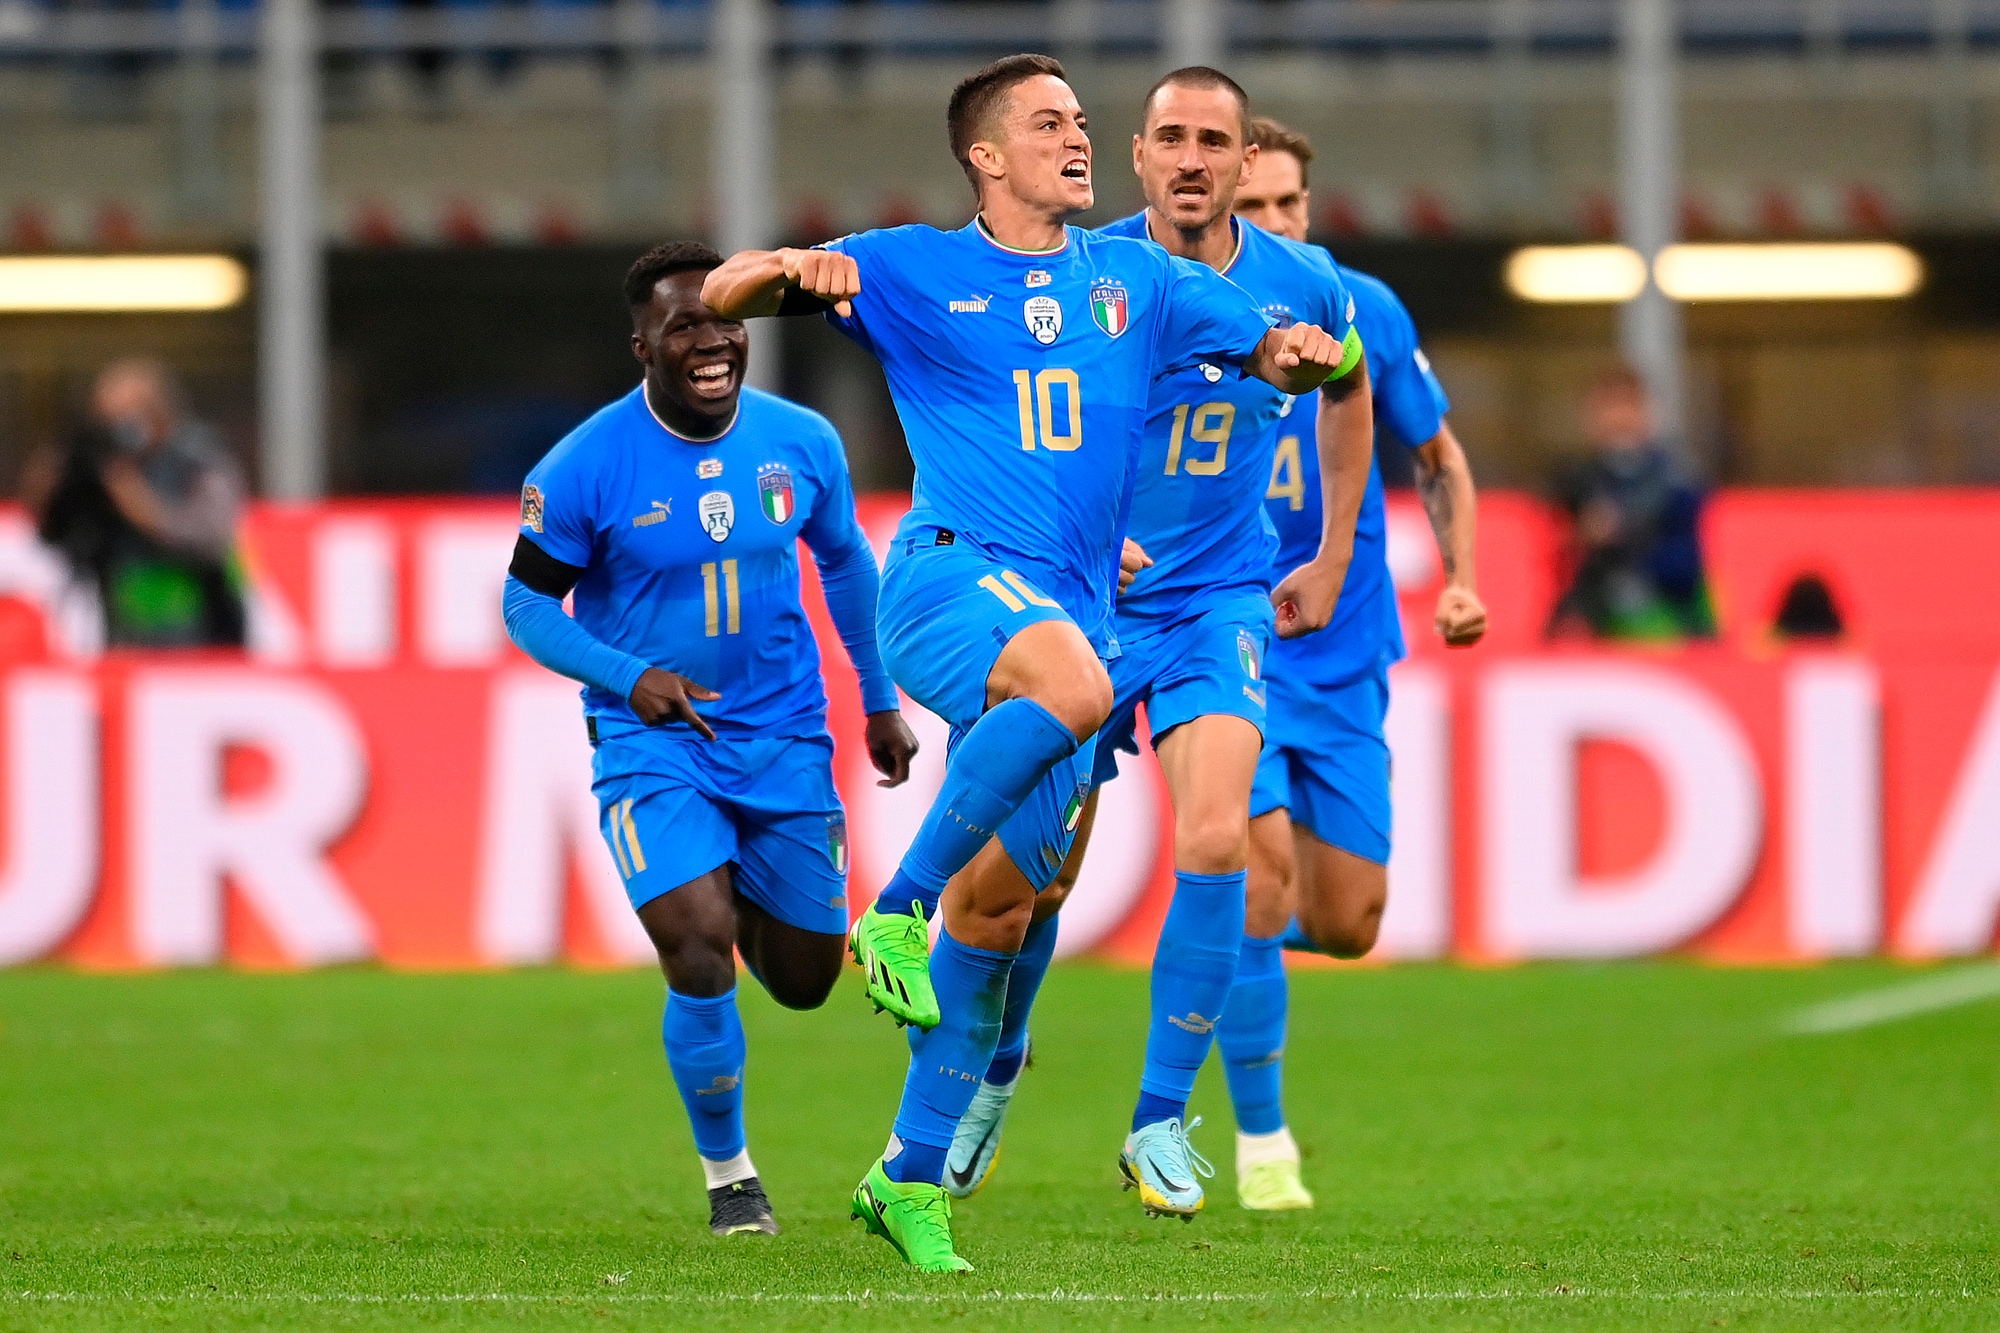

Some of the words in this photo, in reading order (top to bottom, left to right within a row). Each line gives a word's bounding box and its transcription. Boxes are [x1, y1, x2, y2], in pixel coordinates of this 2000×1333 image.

[949, 300, 986, 313] PUMA
[1092, 290, 1124, 299] ITALIA
[1012, 367, 1083, 452] 10
[1164, 402, 1236, 476] 19
[1265, 435, 1306, 512] 4
[701, 559, 740, 637] 11
[609, 798, 648, 880] 11
